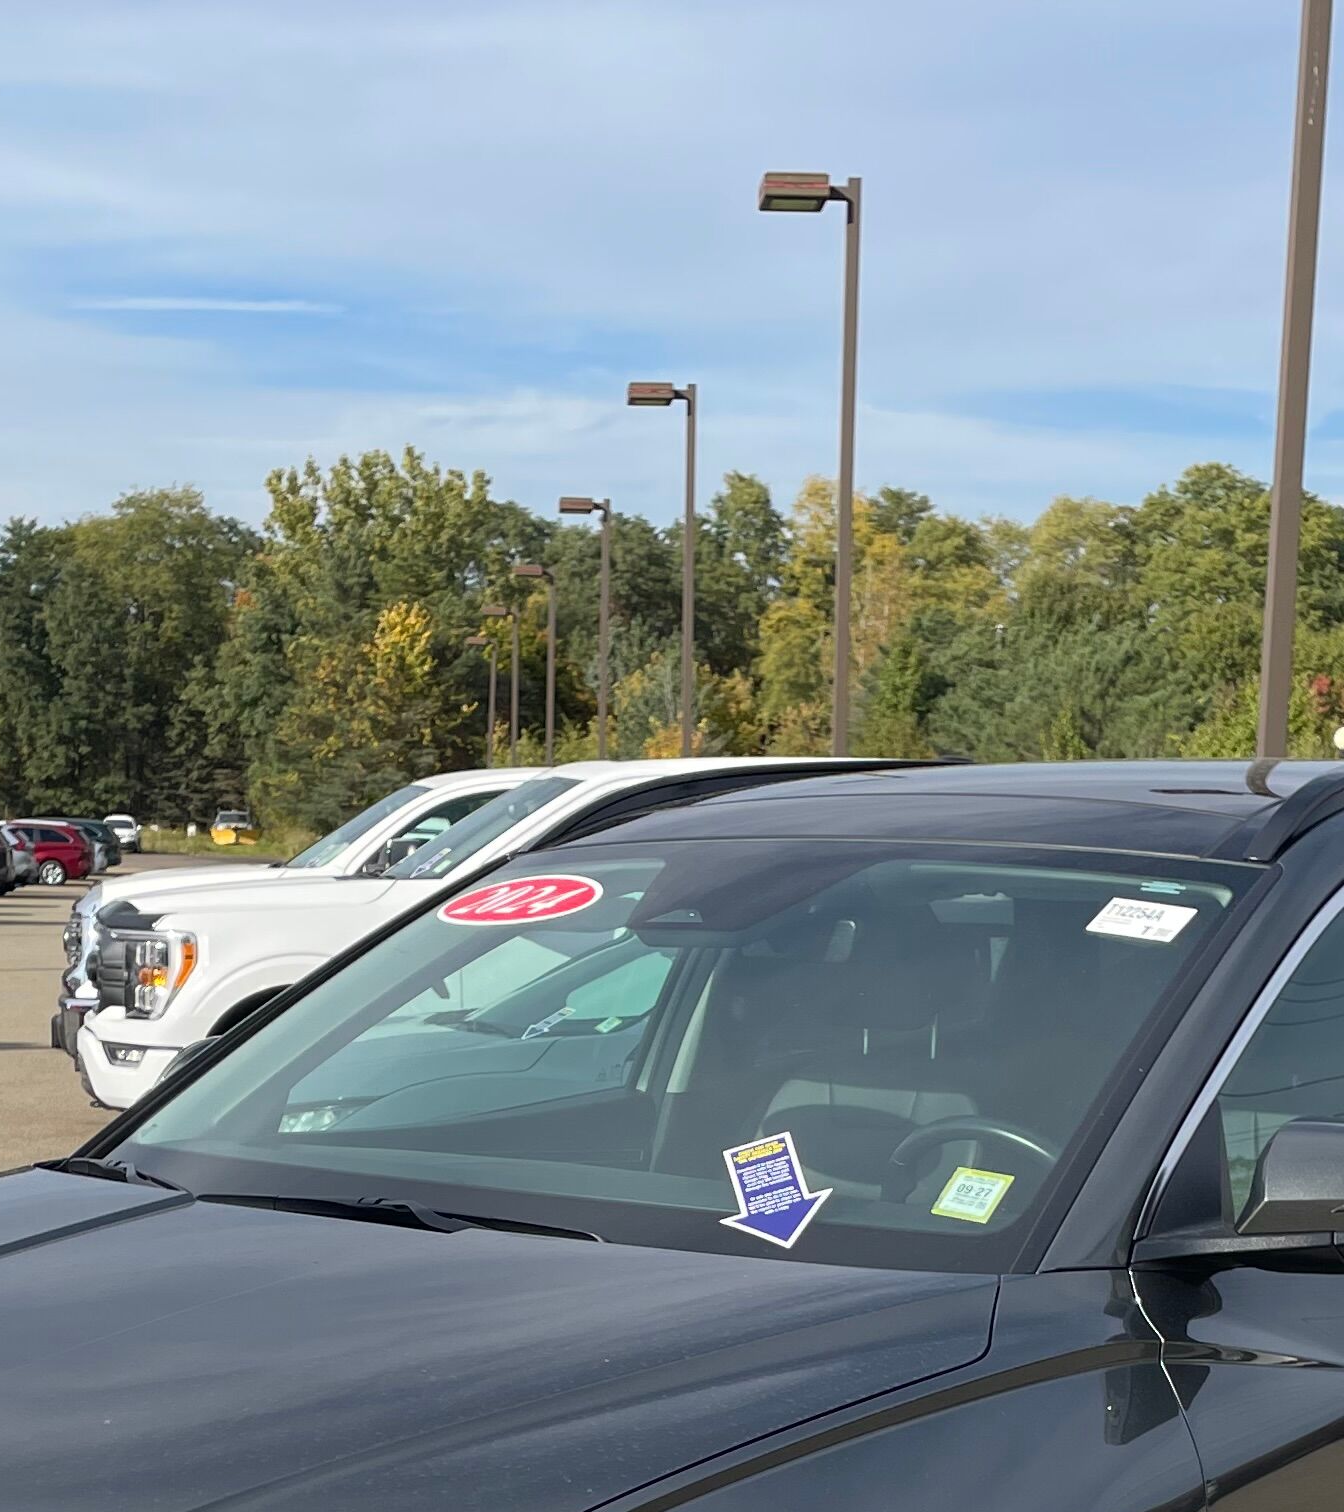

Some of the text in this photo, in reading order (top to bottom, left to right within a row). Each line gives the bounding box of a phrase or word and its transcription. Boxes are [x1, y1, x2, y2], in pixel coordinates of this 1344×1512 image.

[448, 885, 590, 915] 2024
[956, 1184, 993, 1197] 09 27
